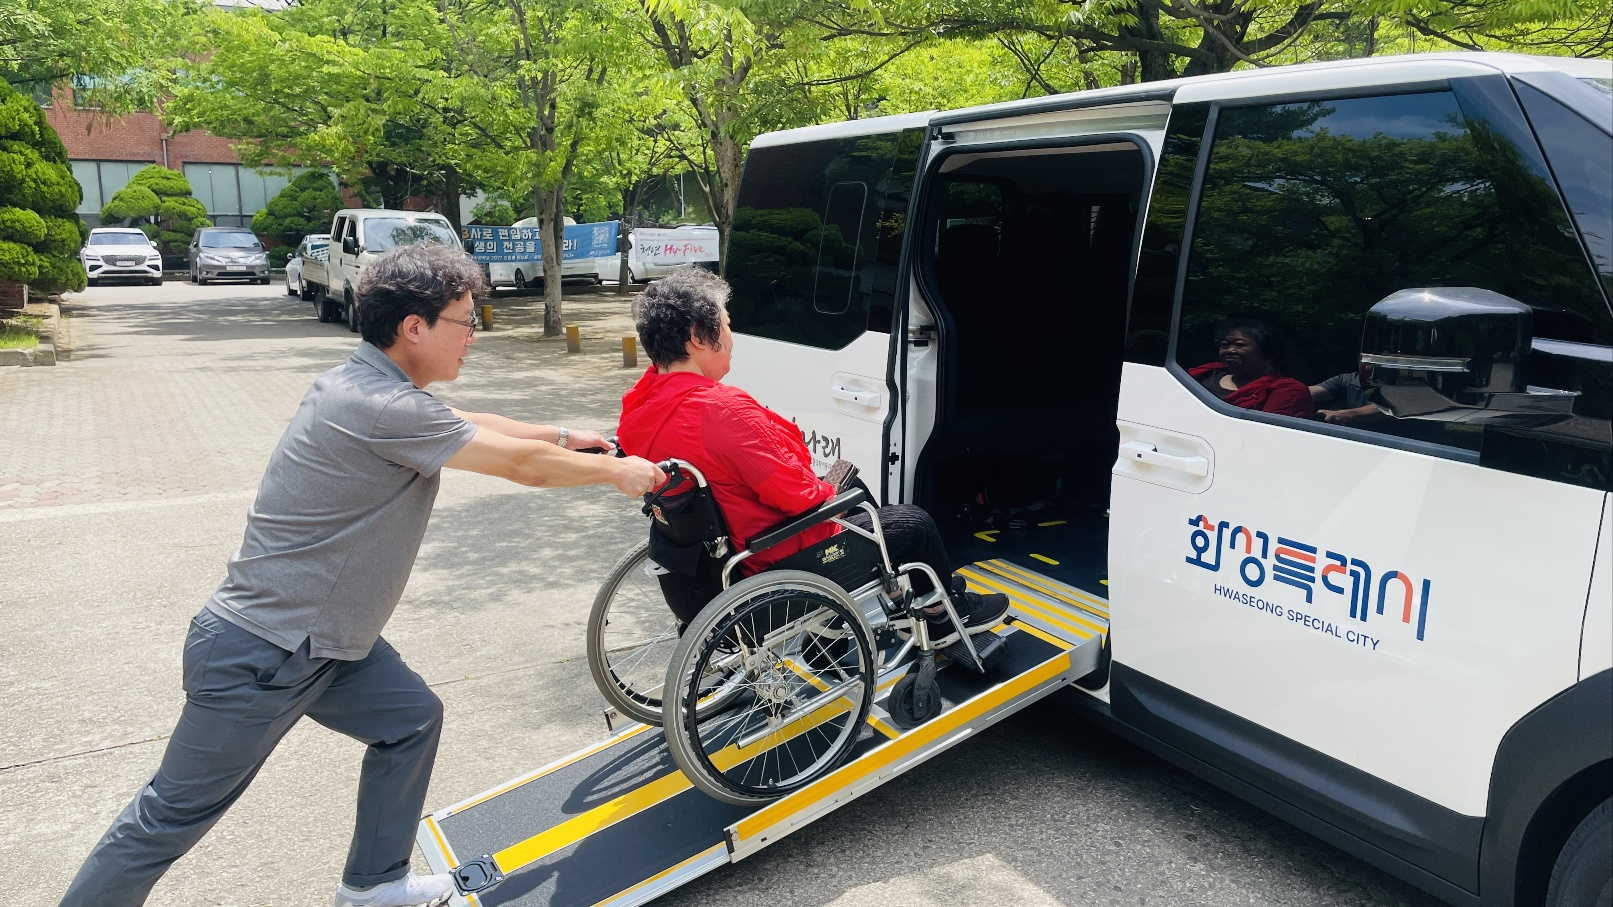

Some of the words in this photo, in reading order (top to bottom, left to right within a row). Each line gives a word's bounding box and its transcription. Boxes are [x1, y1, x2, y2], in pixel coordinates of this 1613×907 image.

[463, 241, 497, 253] 생의
[502, 241, 536, 253] 전공을
[562, 239, 578, 251] 라!
[663, 243, 705, 259] Hy-Five
[1185, 514, 1431, 641] 화성특례시
[1214, 583, 1283, 617] HWASEONG
[1287, 609, 1342, 639] SPECIAL
[1346, 630, 1380, 651] CITY
